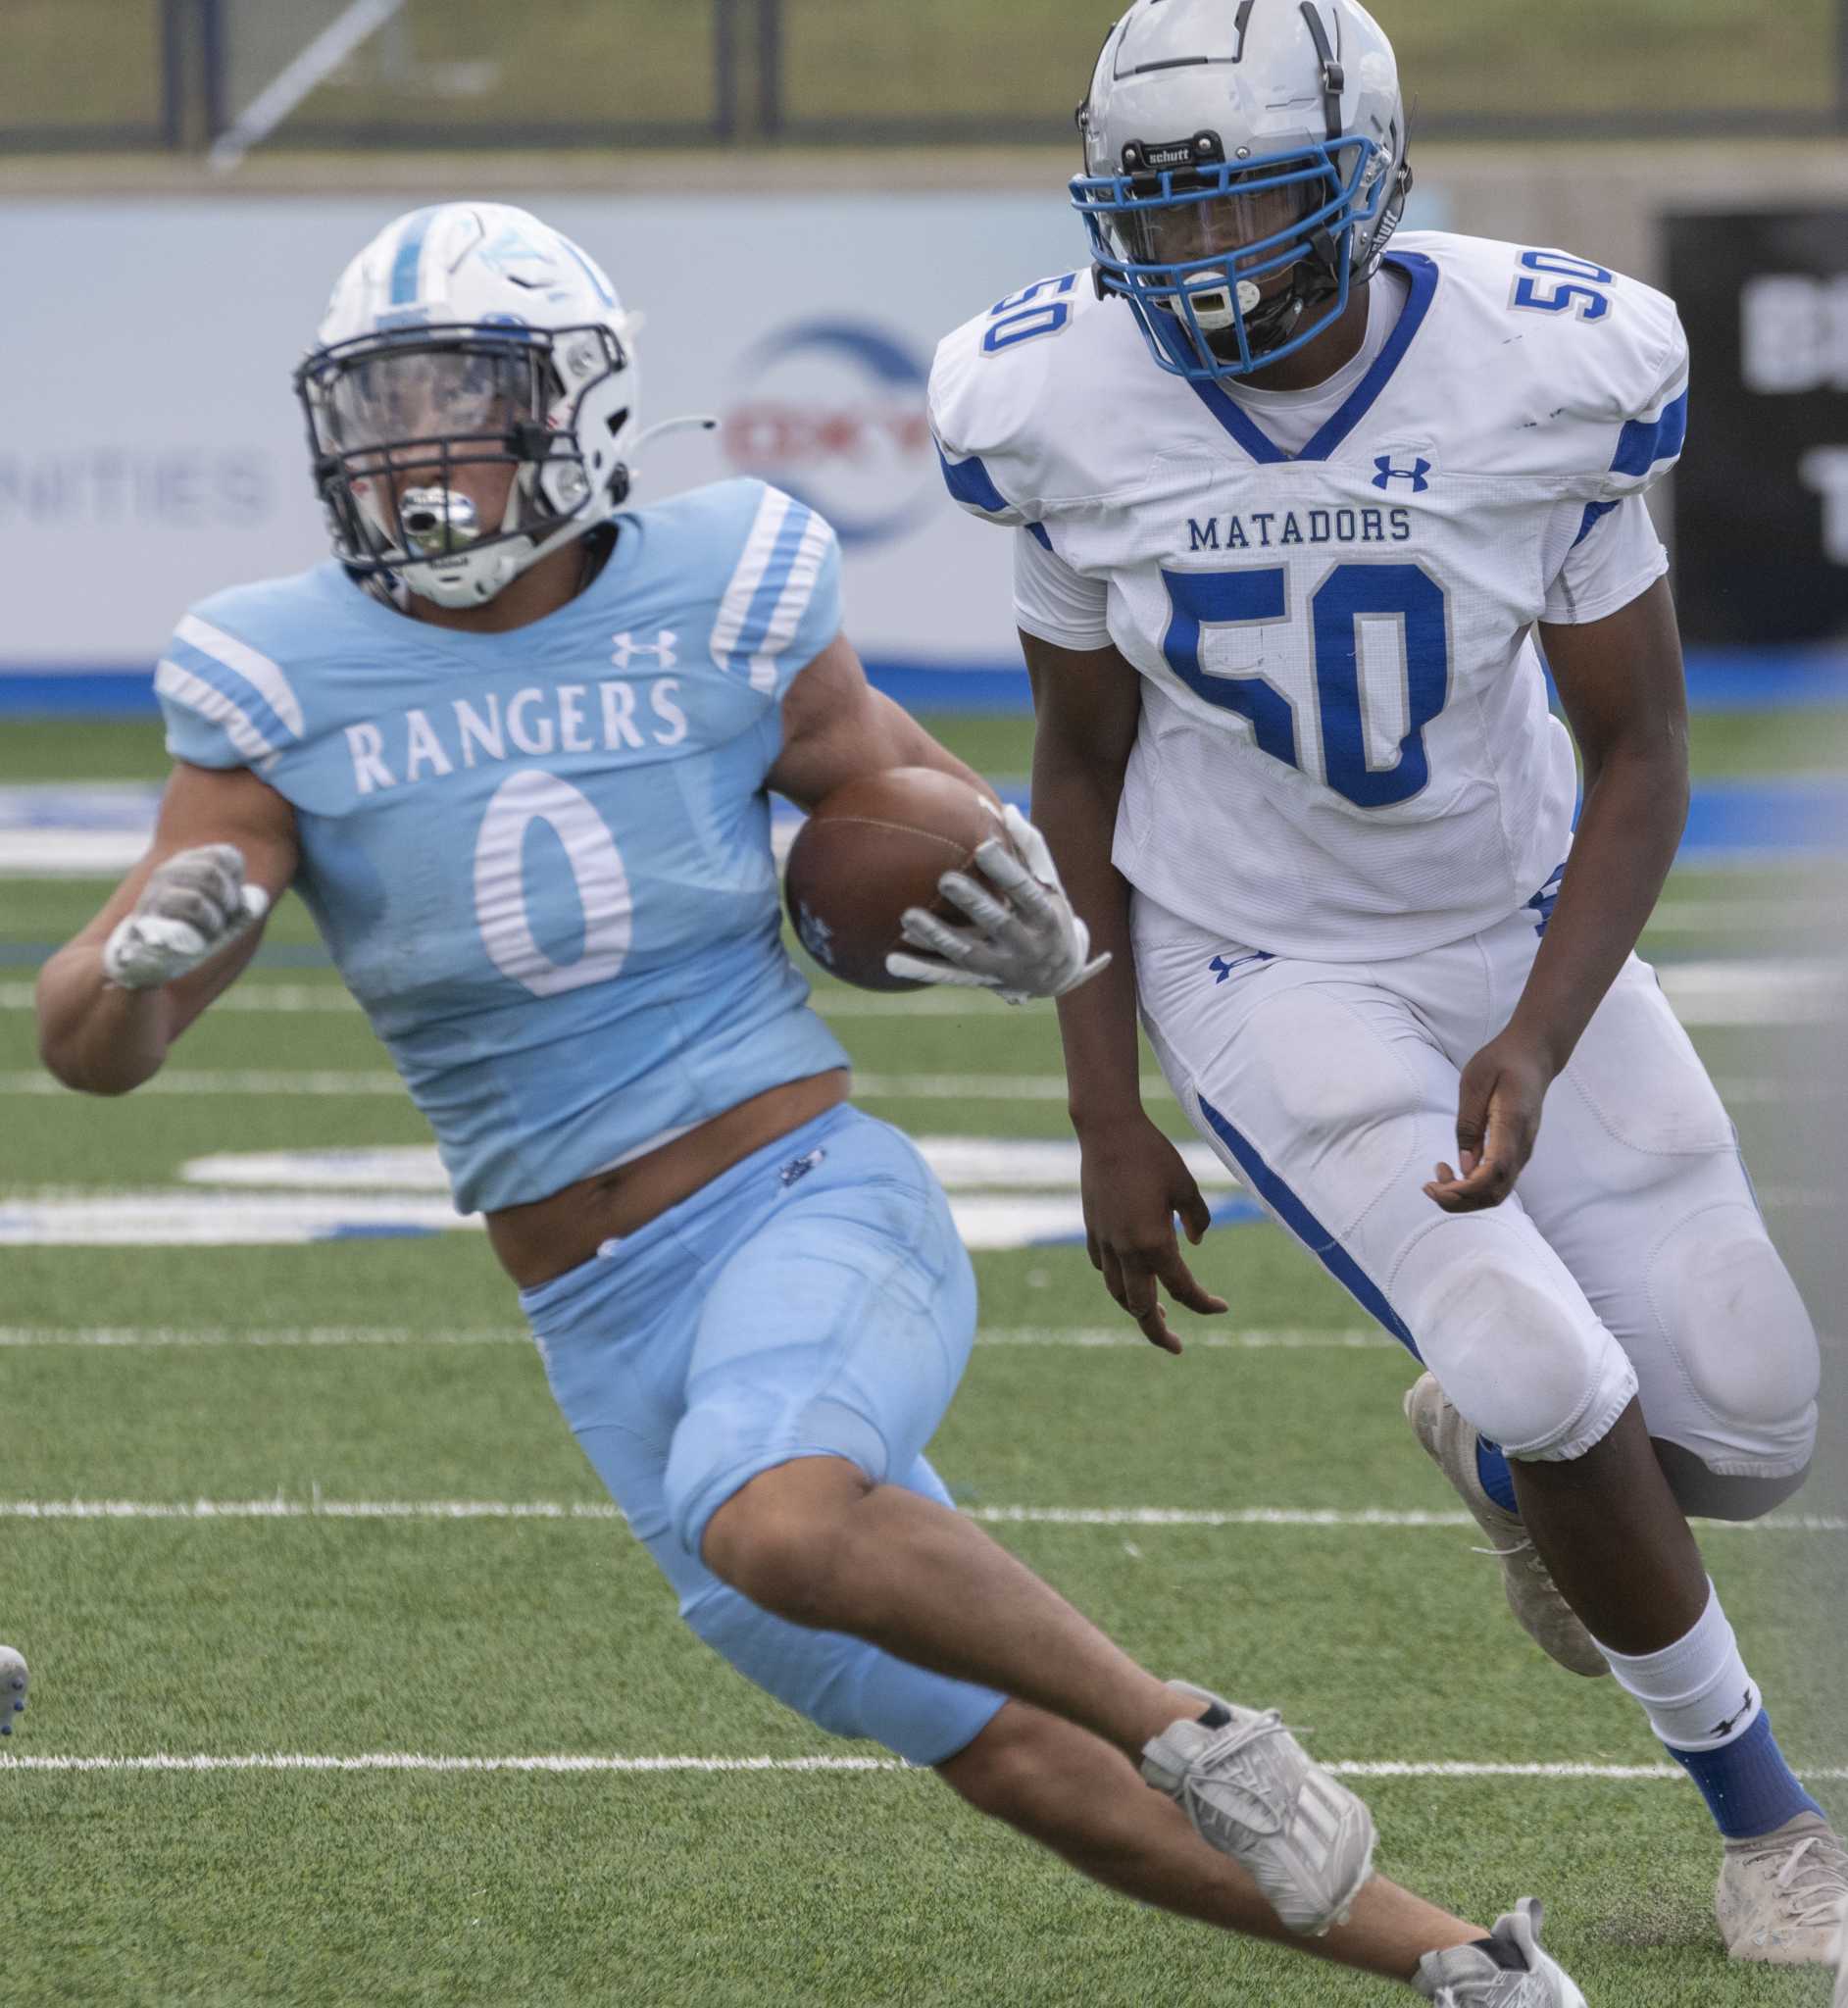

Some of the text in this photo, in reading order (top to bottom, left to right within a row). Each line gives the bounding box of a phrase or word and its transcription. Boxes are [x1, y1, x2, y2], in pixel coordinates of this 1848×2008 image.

[1149, 148, 1189, 165] schutt
[980, 271, 1077, 355] 50
[1512, 249, 1614, 322] 50
[1186, 508, 1412, 552] MATADORS
[1158, 556, 1454, 812] 50
[343, 678, 689, 795] RANGERS
[473, 769, 633, 997] 0
